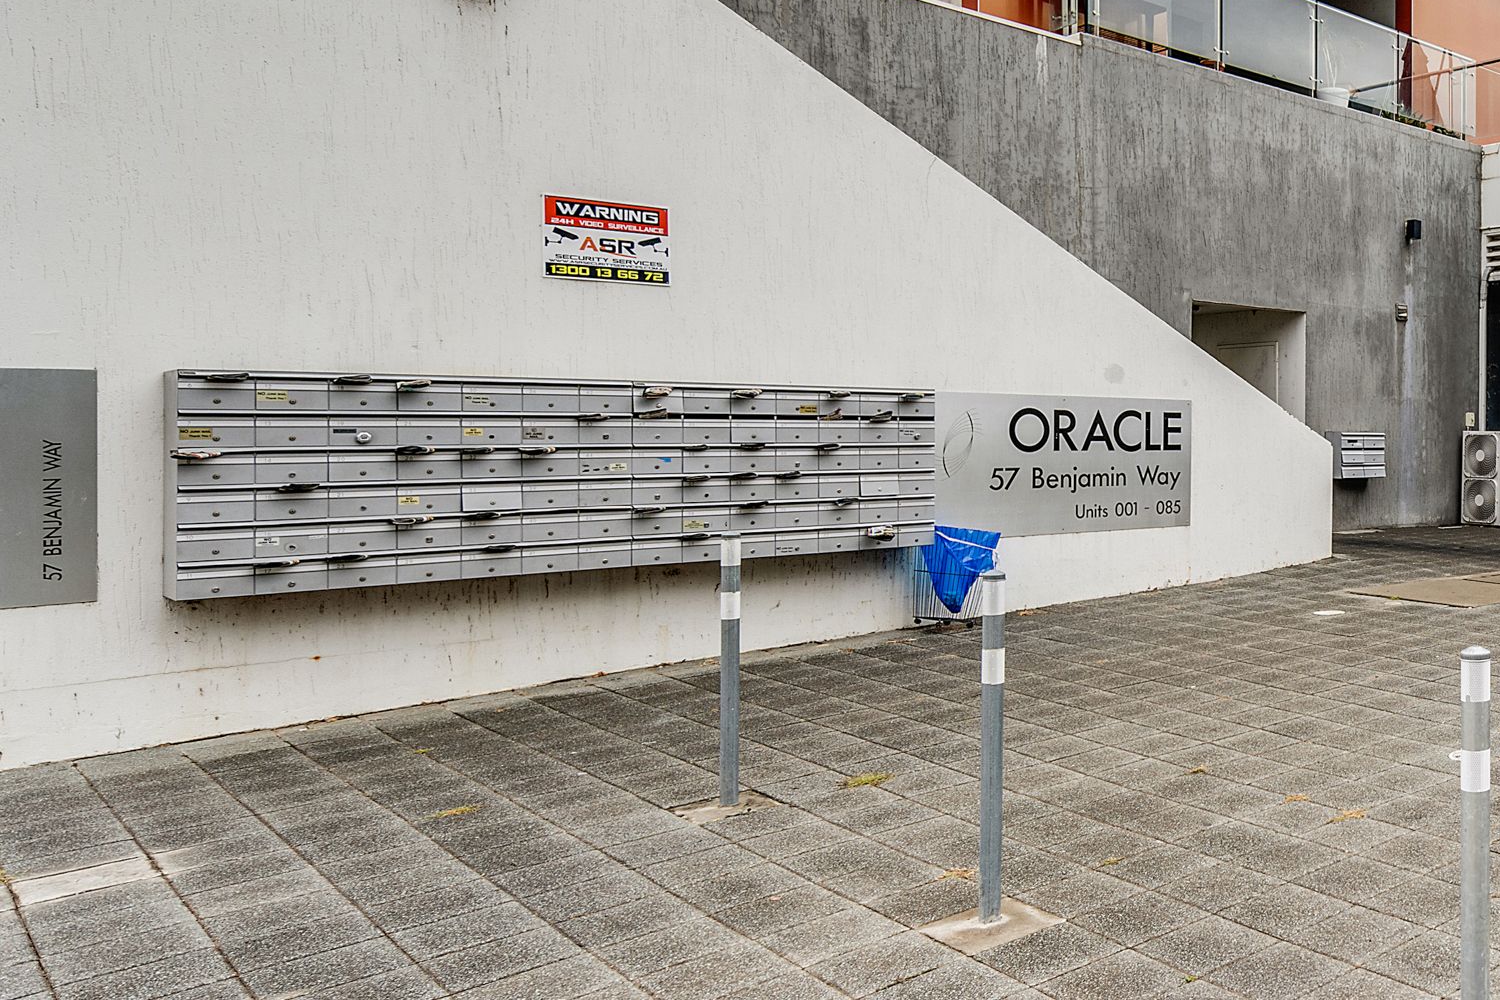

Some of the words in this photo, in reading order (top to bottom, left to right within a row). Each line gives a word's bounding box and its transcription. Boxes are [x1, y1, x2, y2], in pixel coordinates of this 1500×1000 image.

[556, 201, 659, 224] WARNING
[550, 217, 574, 225] 24H
[579, 219, 604, 228] VIDEO
[607, 223, 664, 234] SURVEILLANCE
[579, 236, 636, 255] ASR
[555, 253, 609, 263] SECURITY
[612, 258, 663, 267] SERVICES
[550, 264, 590, 276] 1300
[595, 268, 612, 278] 13
[617, 270, 639, 280] 66
[643, 272, 664, 282] 72
[1009, 407, 1182, 452] ORACLE
[42, 439, 62, 472] WAY
[989, 467, 1021, 491] 57
[1032, 466, 1127, 494] Benjamin
[1136, 465, 1181, 490] Way
[42, 477, 62, 556] BENJAMIN
[1075, 503, 1109, 519] Units
[1115, 501, 1138, 516] 001
[1156, 500, 1181, 515] 085
[42, 563, 63, 581] 57
